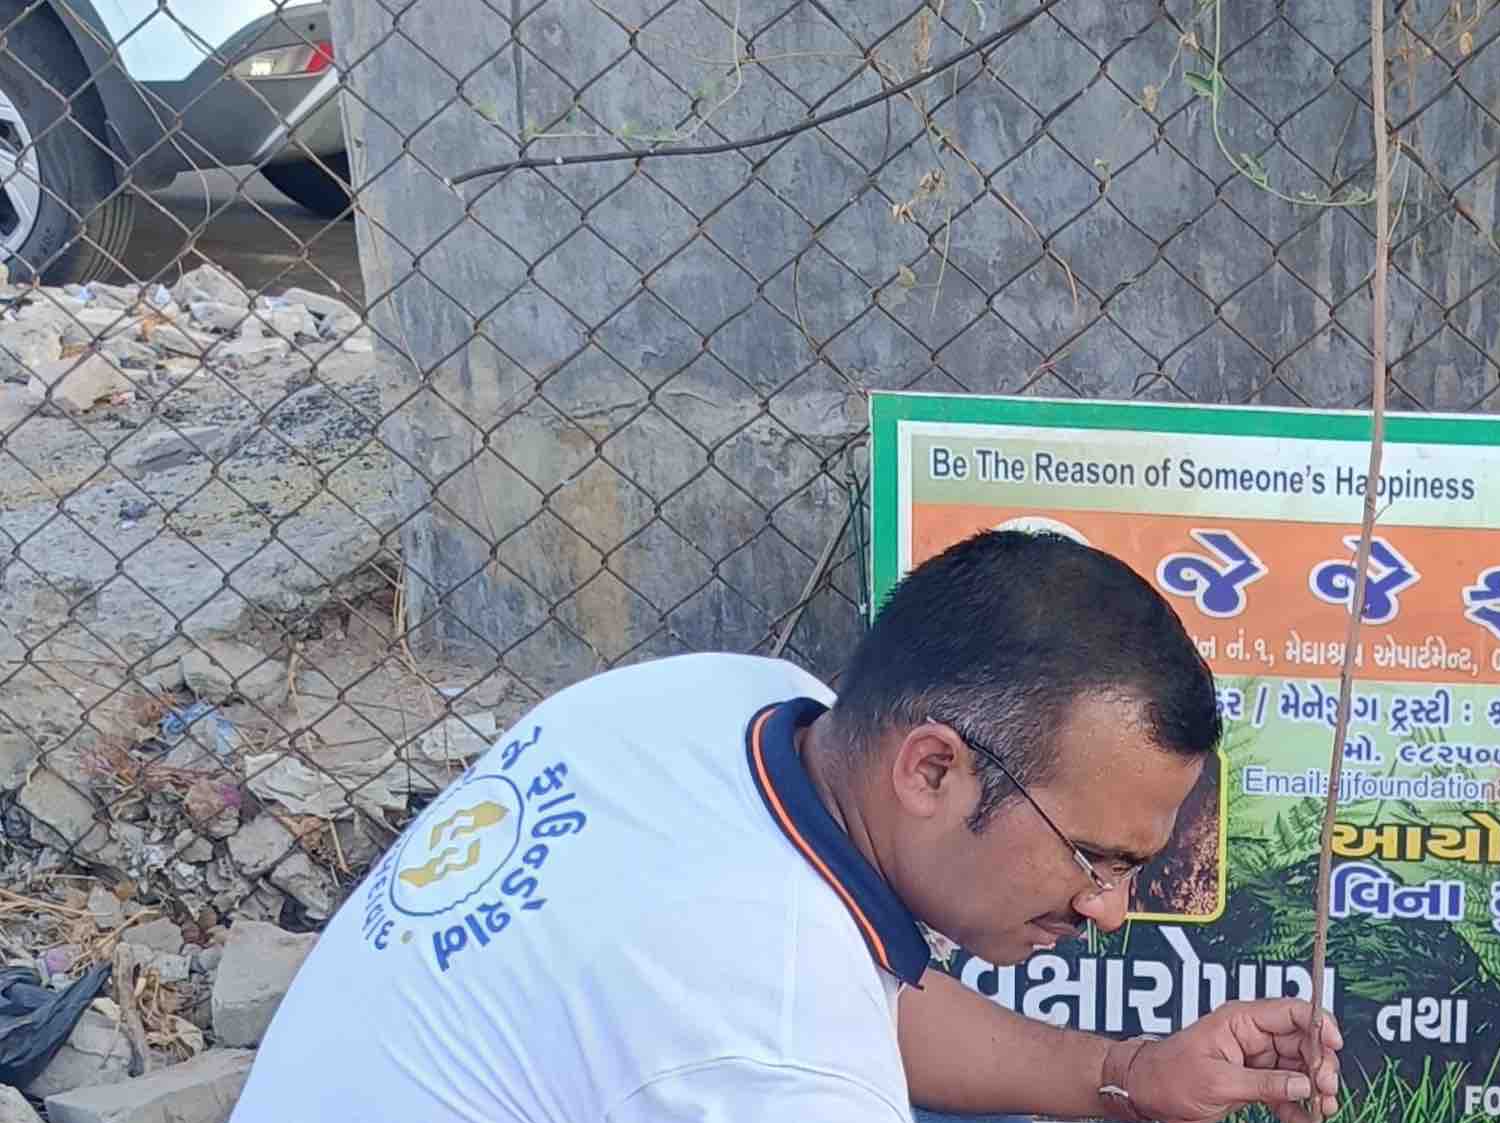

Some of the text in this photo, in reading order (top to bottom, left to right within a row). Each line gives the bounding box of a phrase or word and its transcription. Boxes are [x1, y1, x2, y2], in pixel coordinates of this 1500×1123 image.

[931, 448, 1475, 504] Be The Reason of Someone's Happiness
[1158, 529, 1266, 617] જે
[1312, 536, 1421, 623] જે
[1391, 689, 1451, 733] ટ્રસ્ટી
[1331, 864, 1464, 919] વિના
[1377, 996, 1468, 1045] તથા
